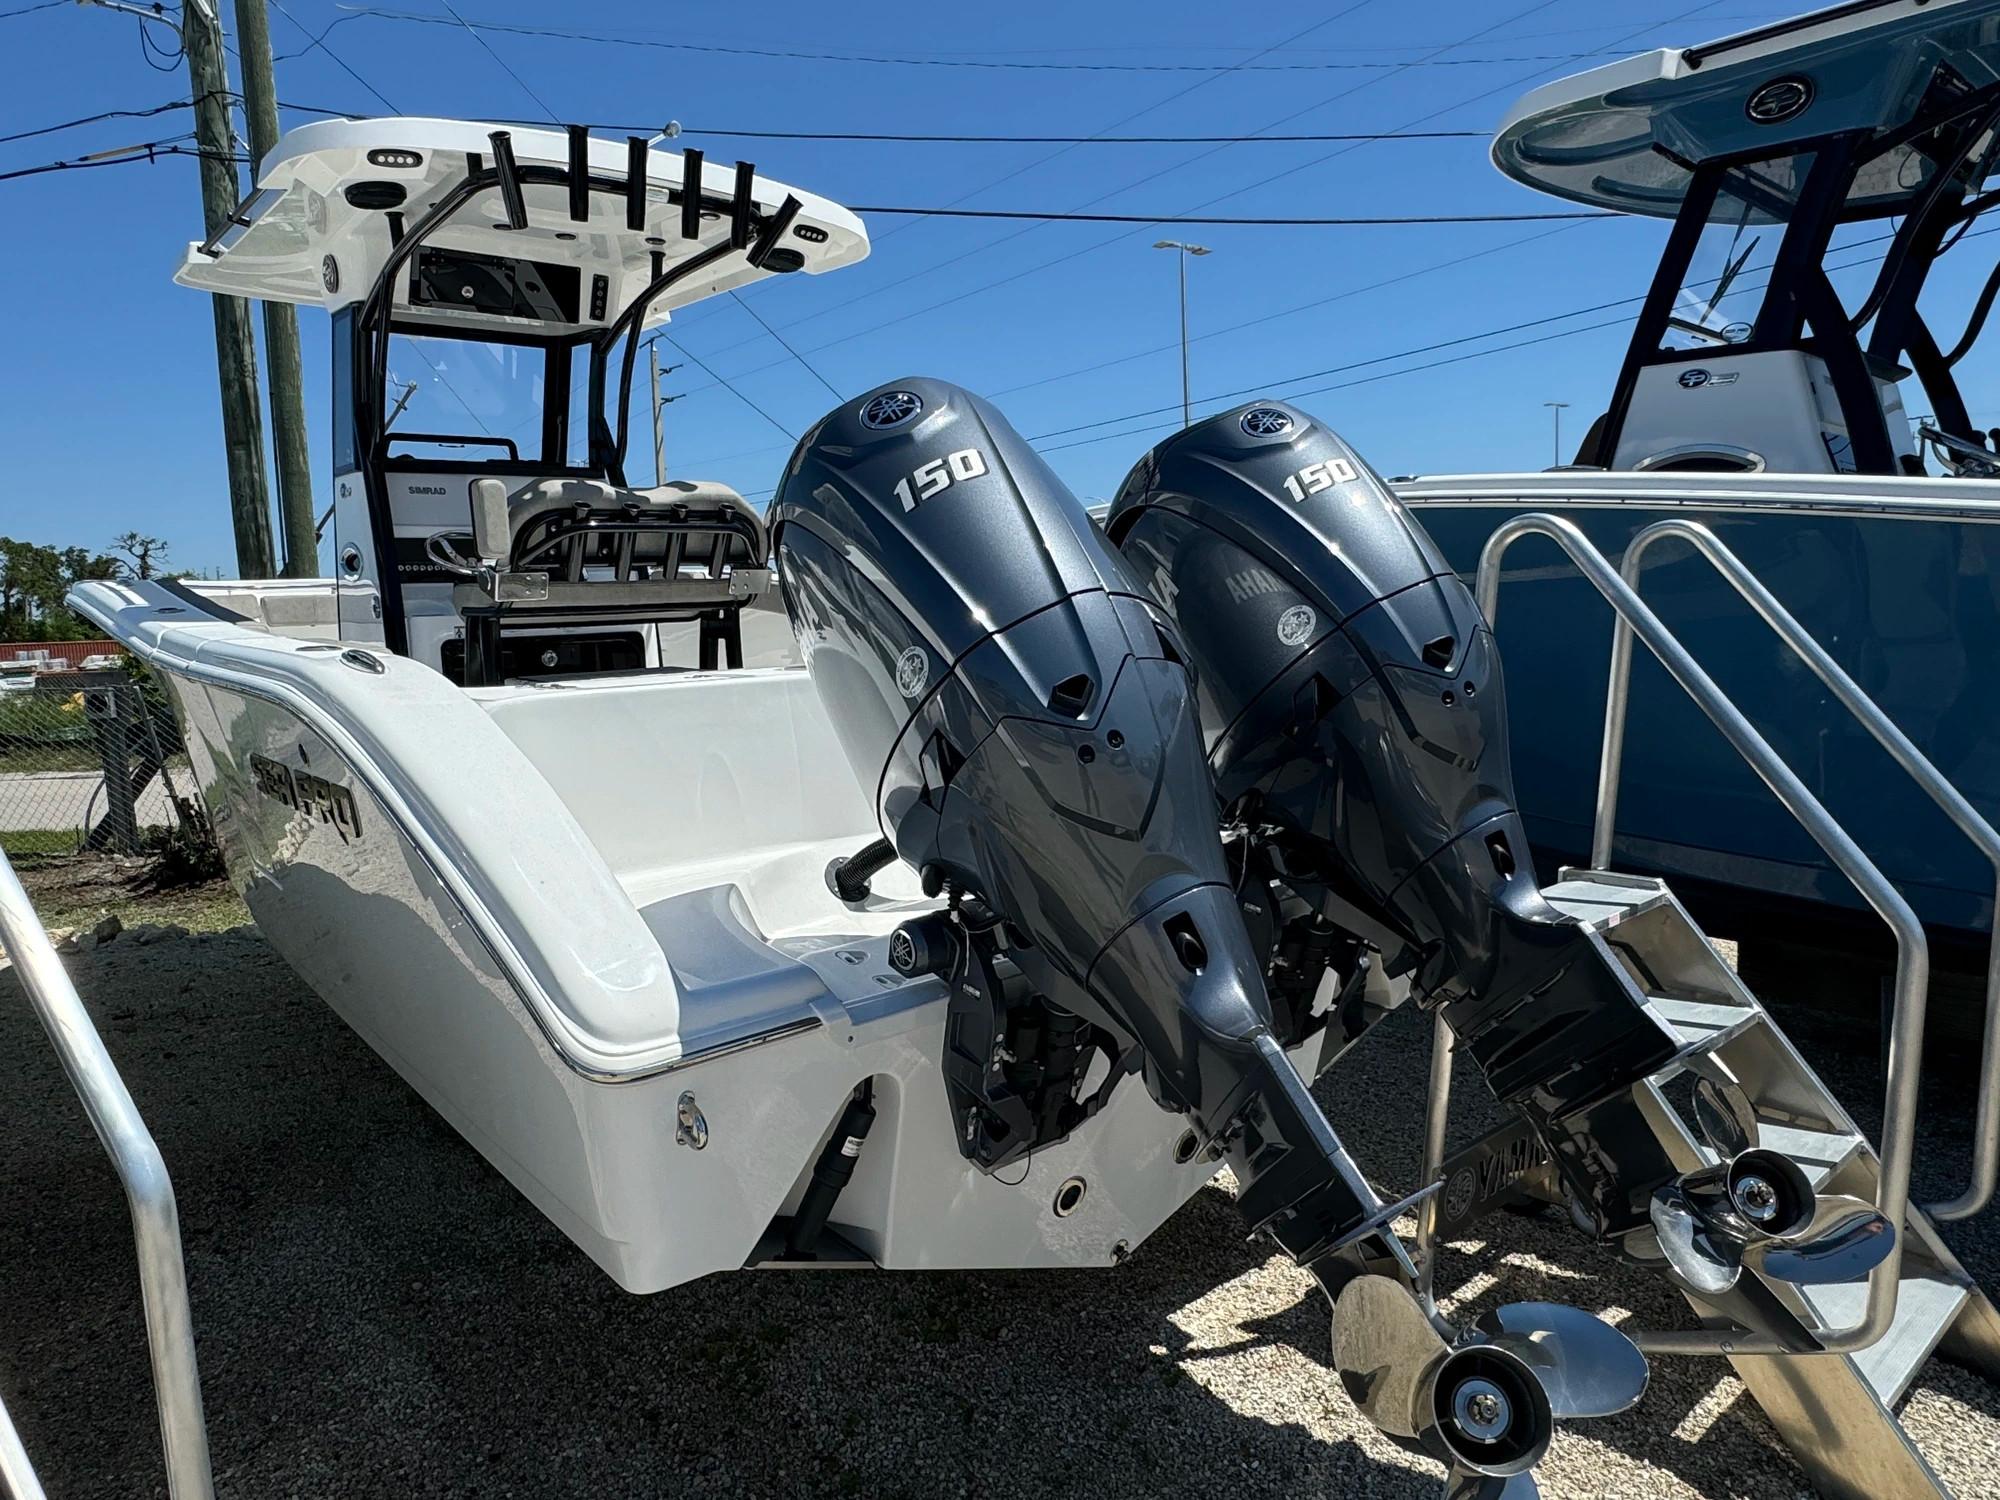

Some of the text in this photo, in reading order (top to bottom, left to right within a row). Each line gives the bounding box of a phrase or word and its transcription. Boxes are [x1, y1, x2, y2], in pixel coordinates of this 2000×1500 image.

[408, 486, 447, 496] SIMRAD
[893, 448, 988, 513] 150
[1283, 458, 1358, 503] 150
